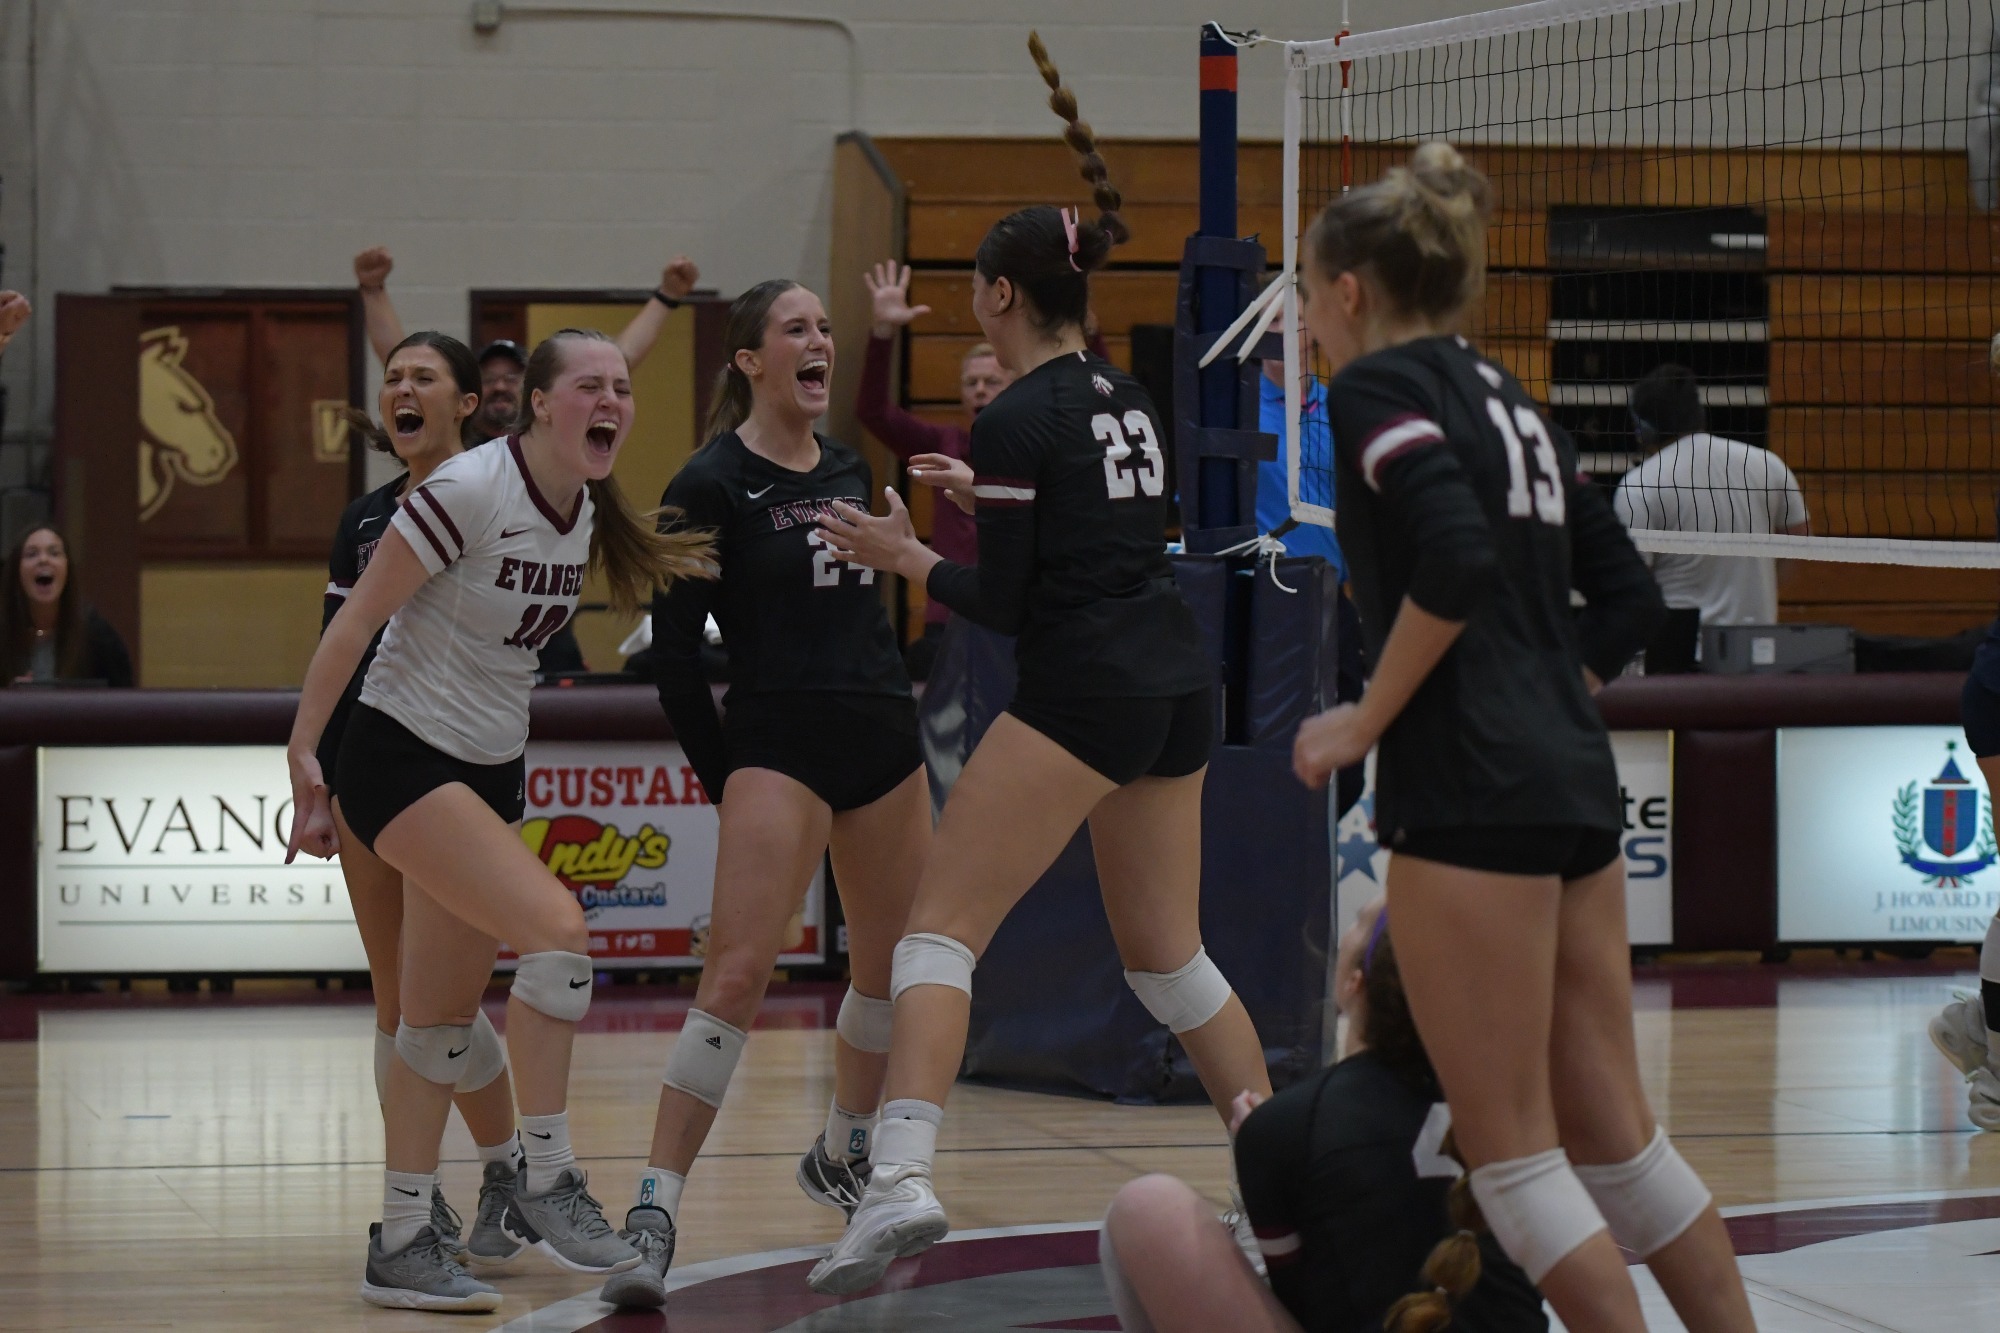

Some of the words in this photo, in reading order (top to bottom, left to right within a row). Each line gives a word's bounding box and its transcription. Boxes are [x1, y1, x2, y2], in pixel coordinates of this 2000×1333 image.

[1091, 410, 1164, 499] 23
[1485, 397, 1565, 526] 13
[503, 604, 568, 650] 10
[60, 884, 332, 905] UNIVERSI
[581, 882, 666, 907] Custard
[1891, 891, 1980, 908] HOWARD
